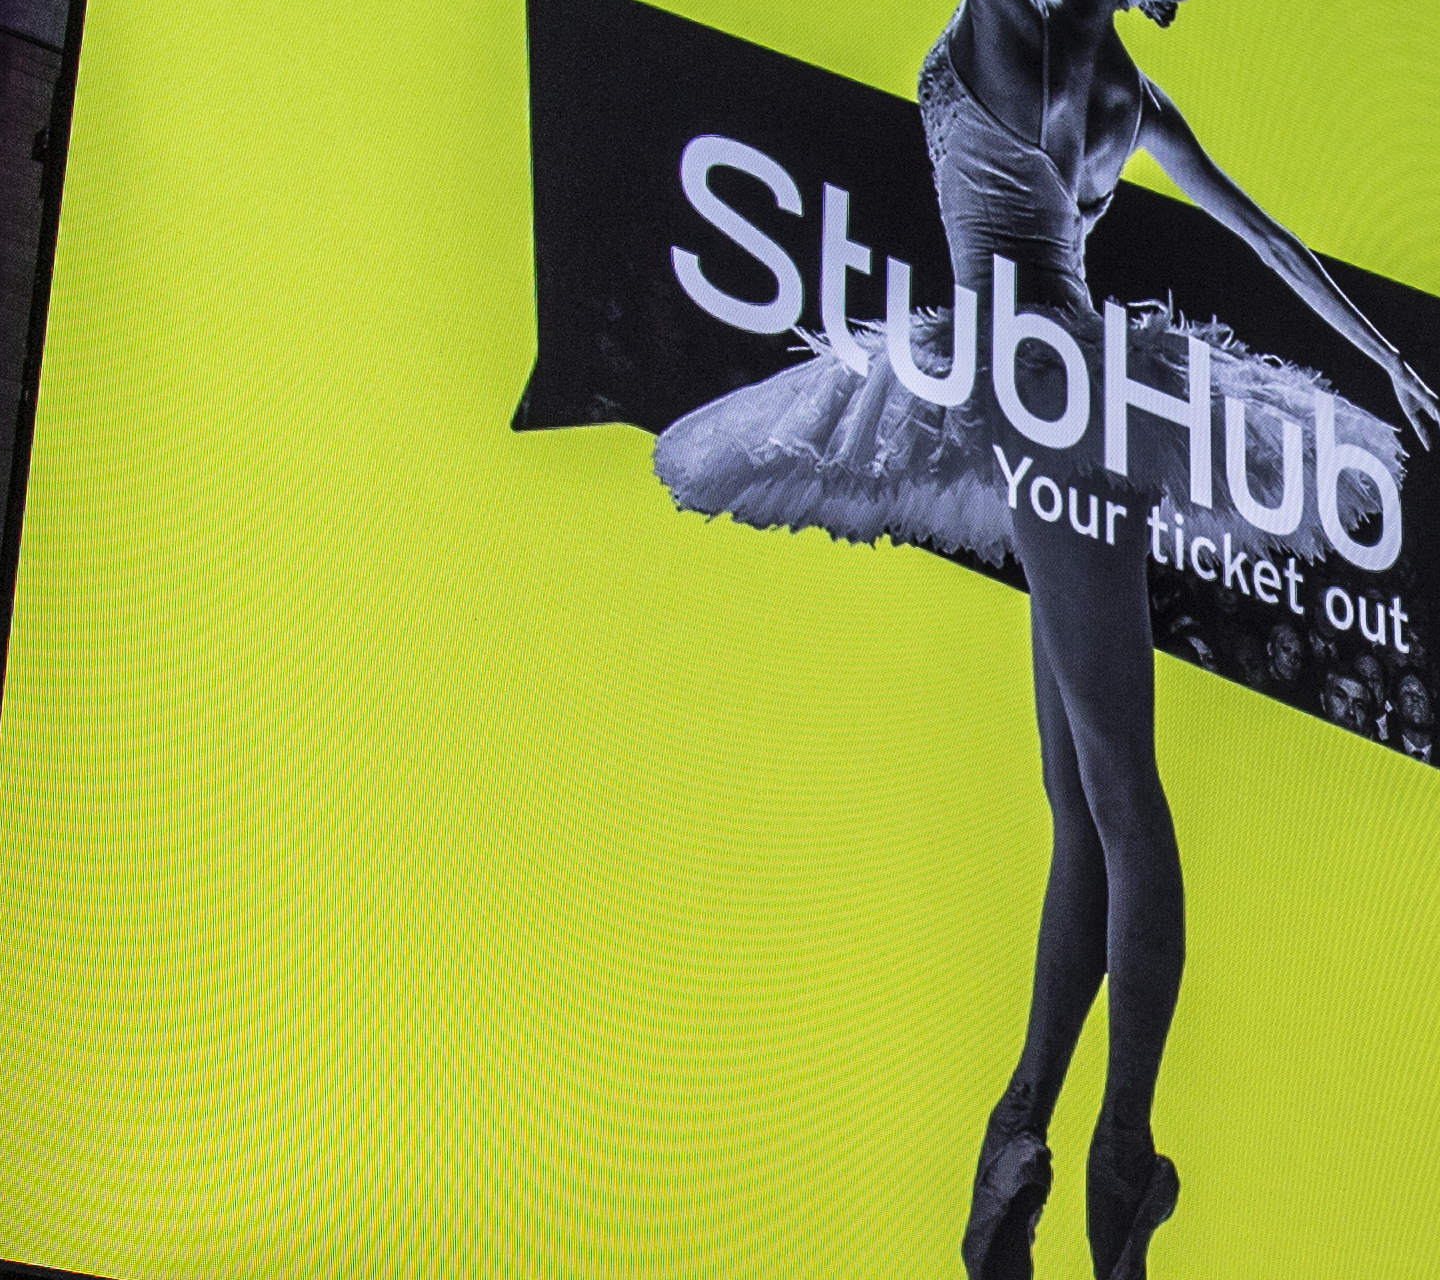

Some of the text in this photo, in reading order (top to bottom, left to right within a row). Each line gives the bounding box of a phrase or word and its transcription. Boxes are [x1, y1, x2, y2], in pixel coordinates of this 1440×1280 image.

[671, 133, 1404, 573] StubHub
[992, 442, 1410, 656] Your ticket out
